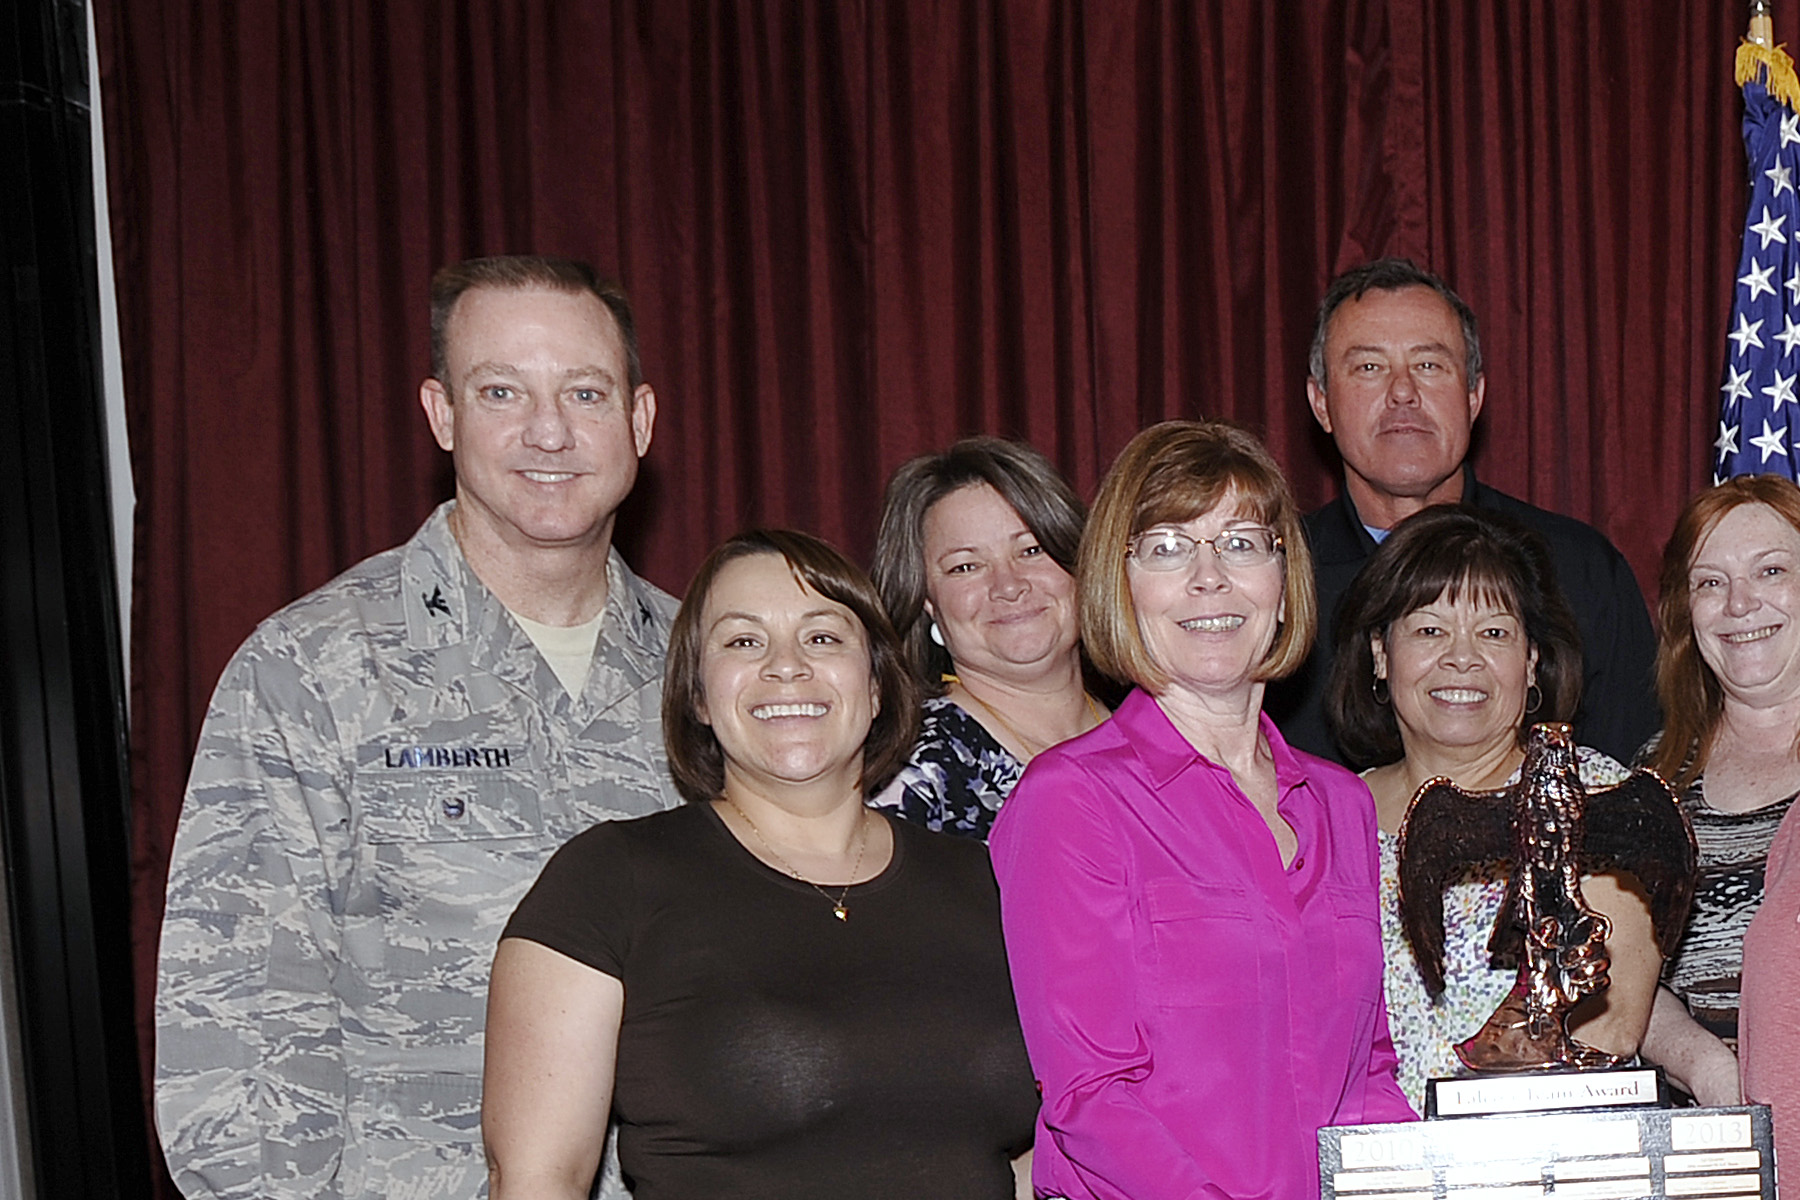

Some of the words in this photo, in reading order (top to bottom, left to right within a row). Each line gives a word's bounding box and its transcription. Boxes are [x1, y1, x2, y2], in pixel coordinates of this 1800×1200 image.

[385, 747, 511, 768] LAMBERTH
[1580, 1080, 1640, 1098] Award
[1685, 1121, 1743, 1144] 2013
